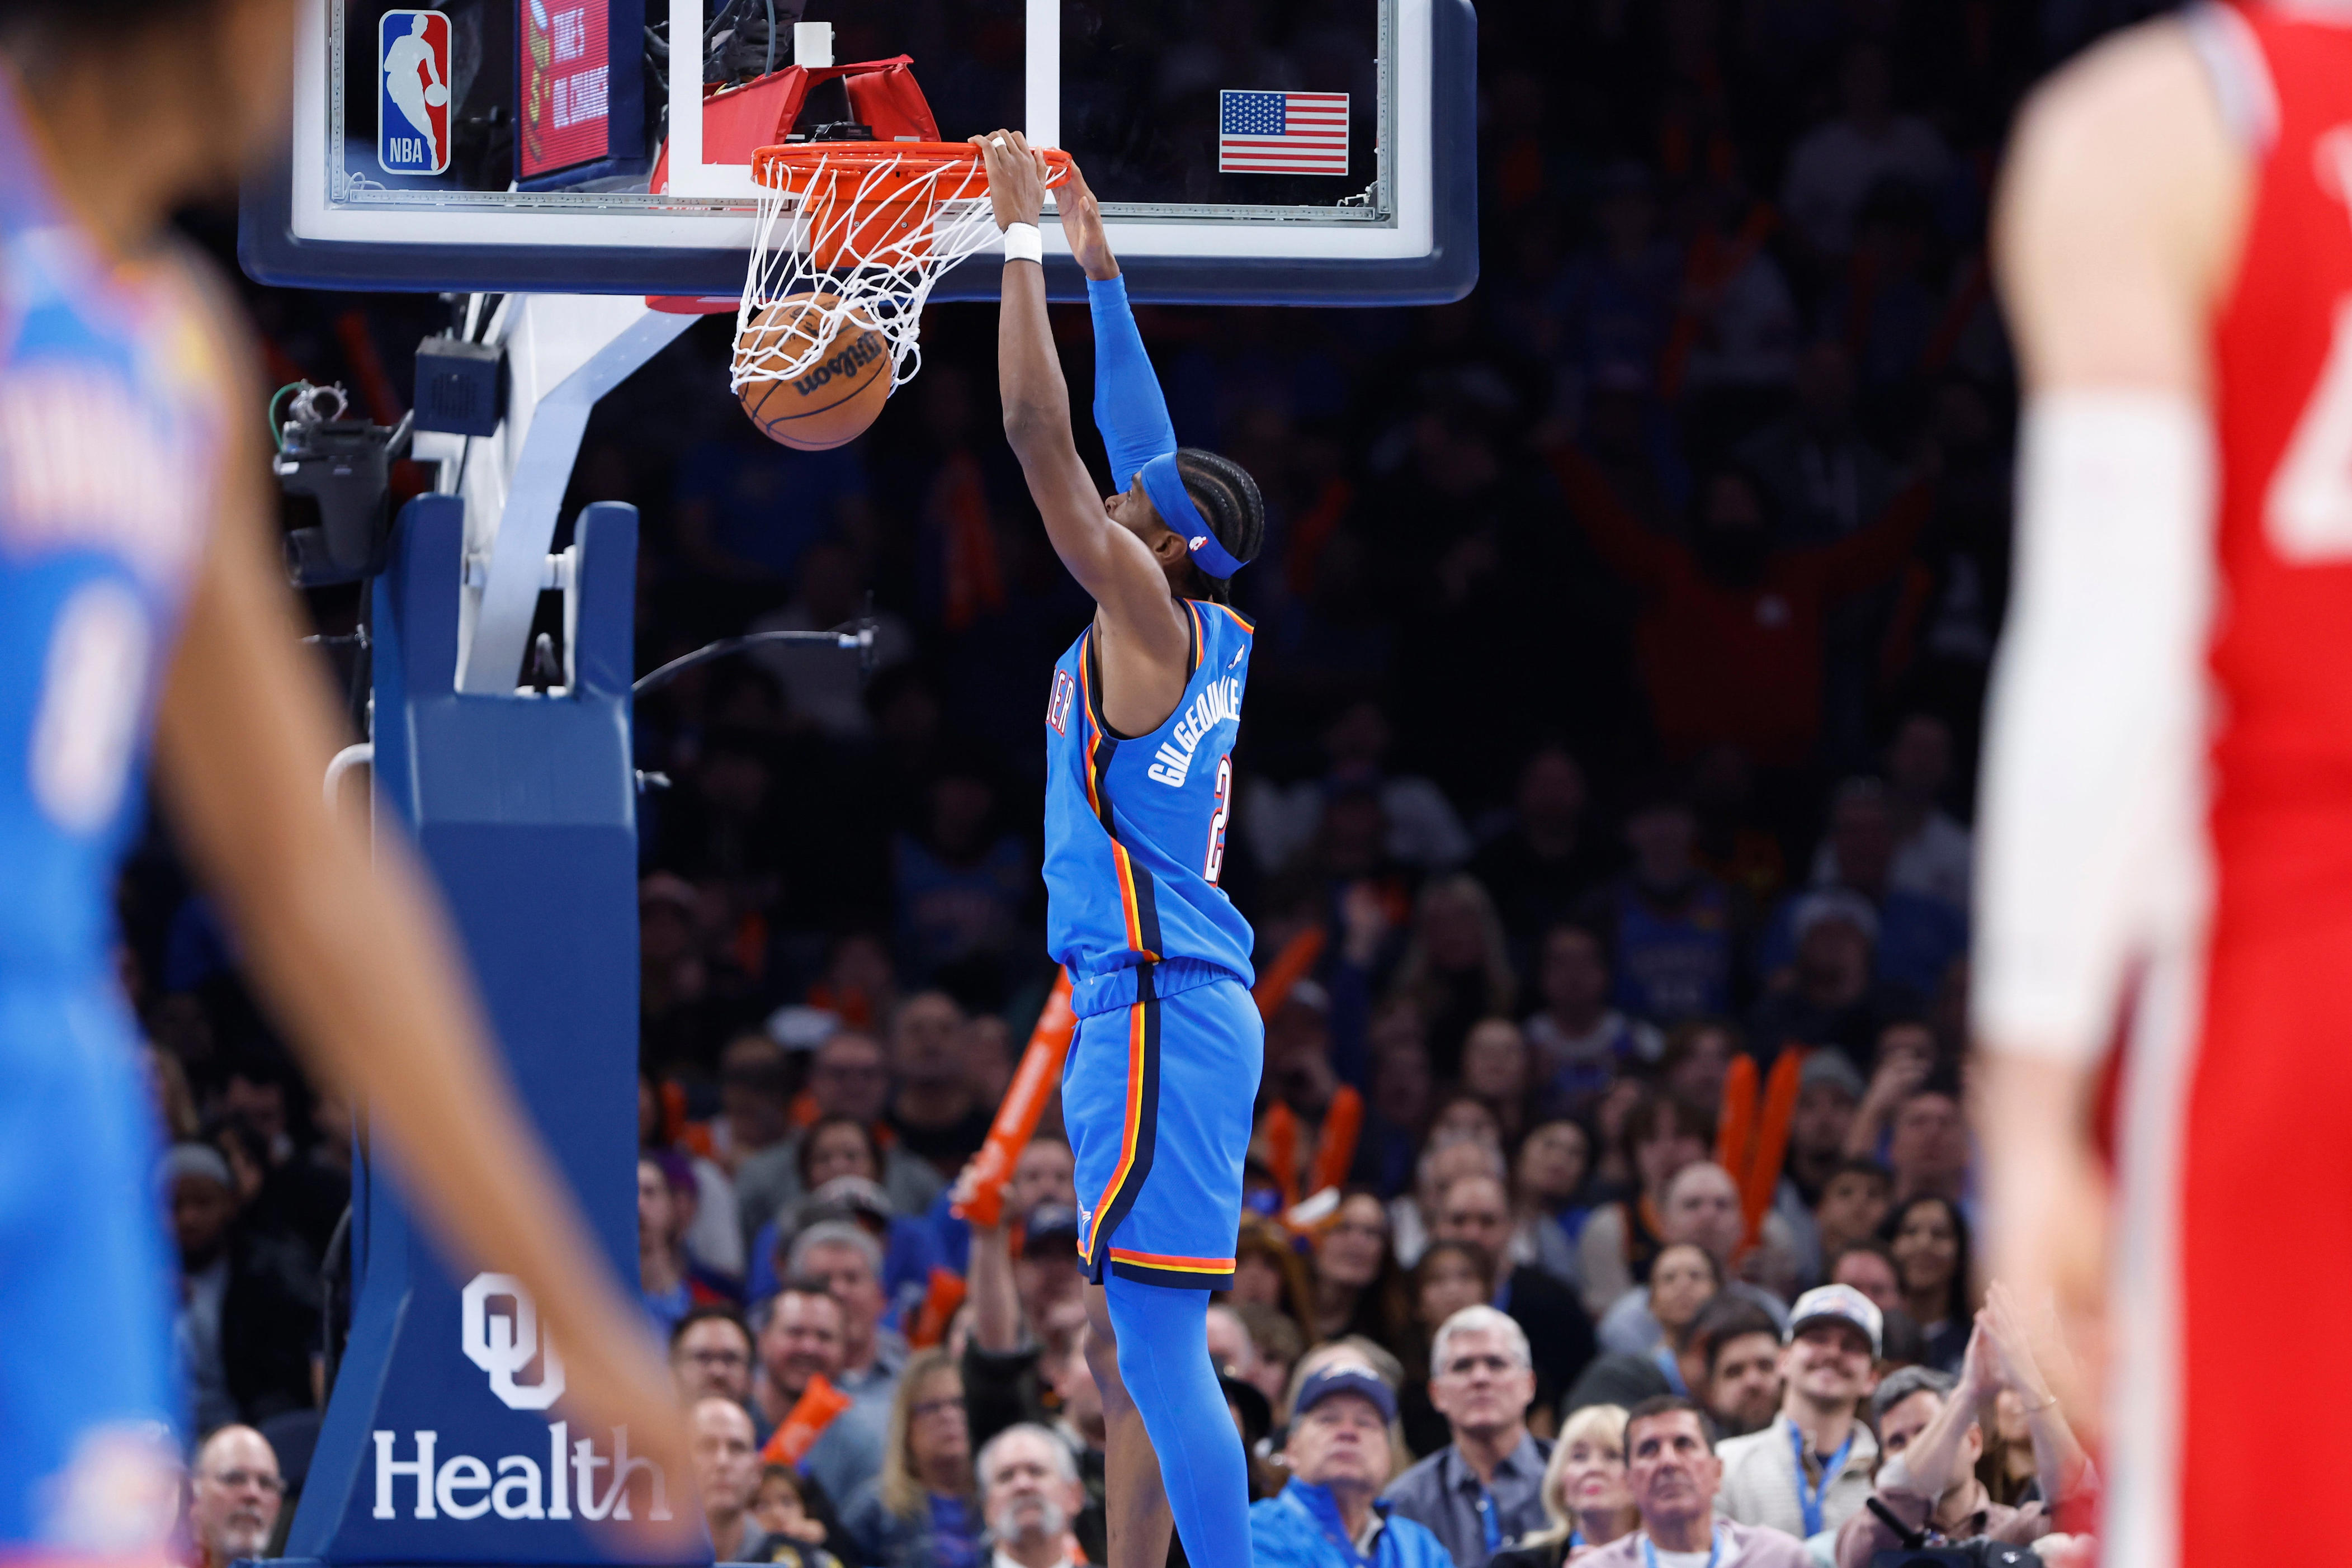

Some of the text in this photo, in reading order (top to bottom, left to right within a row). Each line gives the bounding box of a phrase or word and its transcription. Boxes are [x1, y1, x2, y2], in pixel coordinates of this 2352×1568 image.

[390, 138, 423, 163] NBA
[792, 331, 882, 397] Wilson
[1046, 665, 1074, 737] ER
[1203, 754, 1232, 888] 2
[373, 1420, 672, 1521] Health
